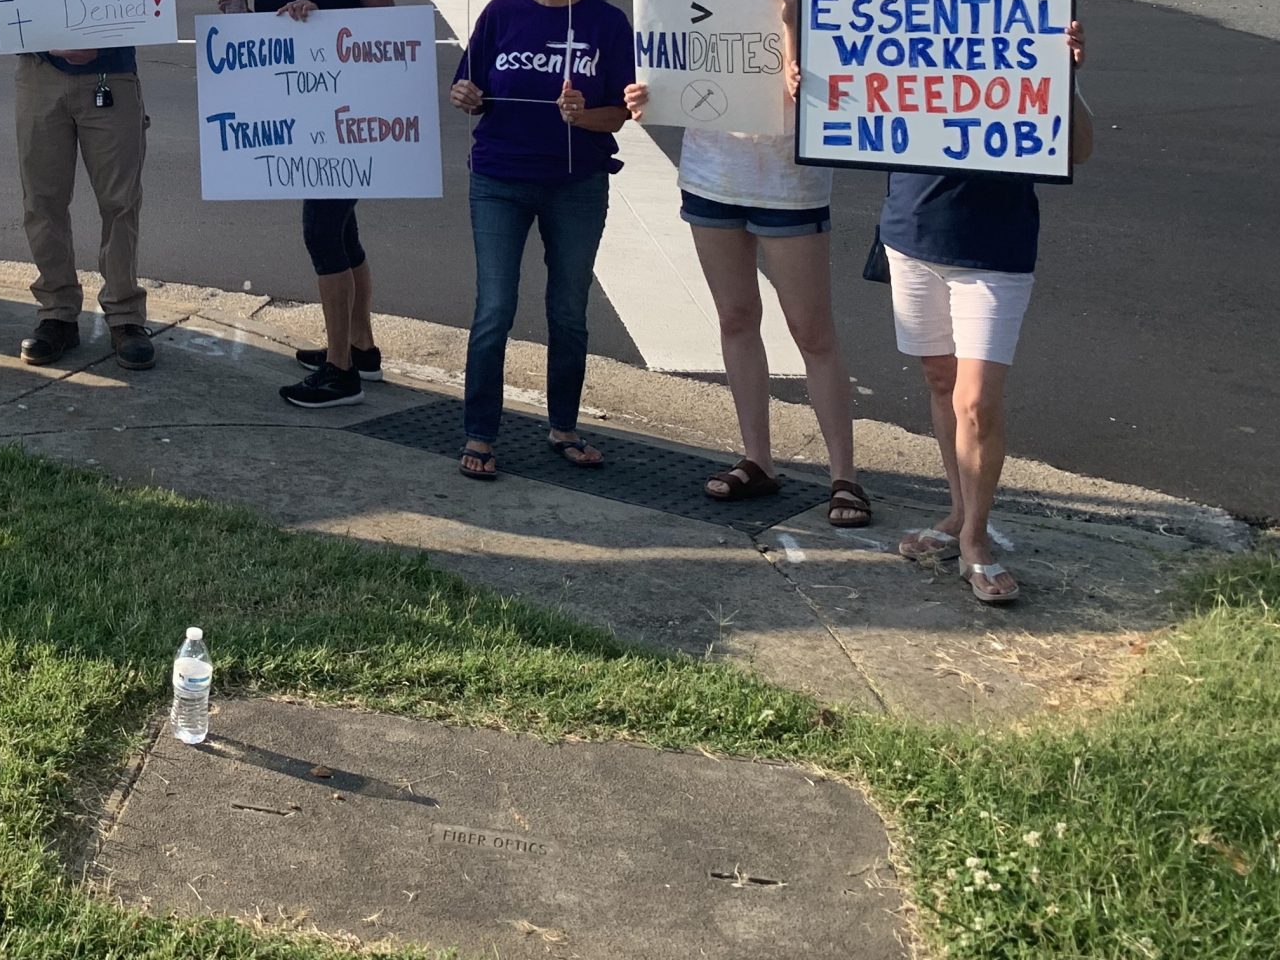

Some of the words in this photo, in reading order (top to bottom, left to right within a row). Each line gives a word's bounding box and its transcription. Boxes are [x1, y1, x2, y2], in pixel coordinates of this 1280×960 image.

[336, 27, 421, 71] CONSENT
[635, 31, 783, 74] MANDATES
[832, 34, 1037, 70] WORKERS
[274, 70, 341, 95] TODAY
[827, 74, 1051, 114] FREEDOM
[206, 112, 296, 151] TYRANNY
[335, 105, 420, 144] FREEDOM
[941, 116, 1062, 161] JOB!
[254, 155, 373, 188] TOMORROW
[443, 829, 486, 847] FIBER
[493, 836, 548, 856] OPTICS
